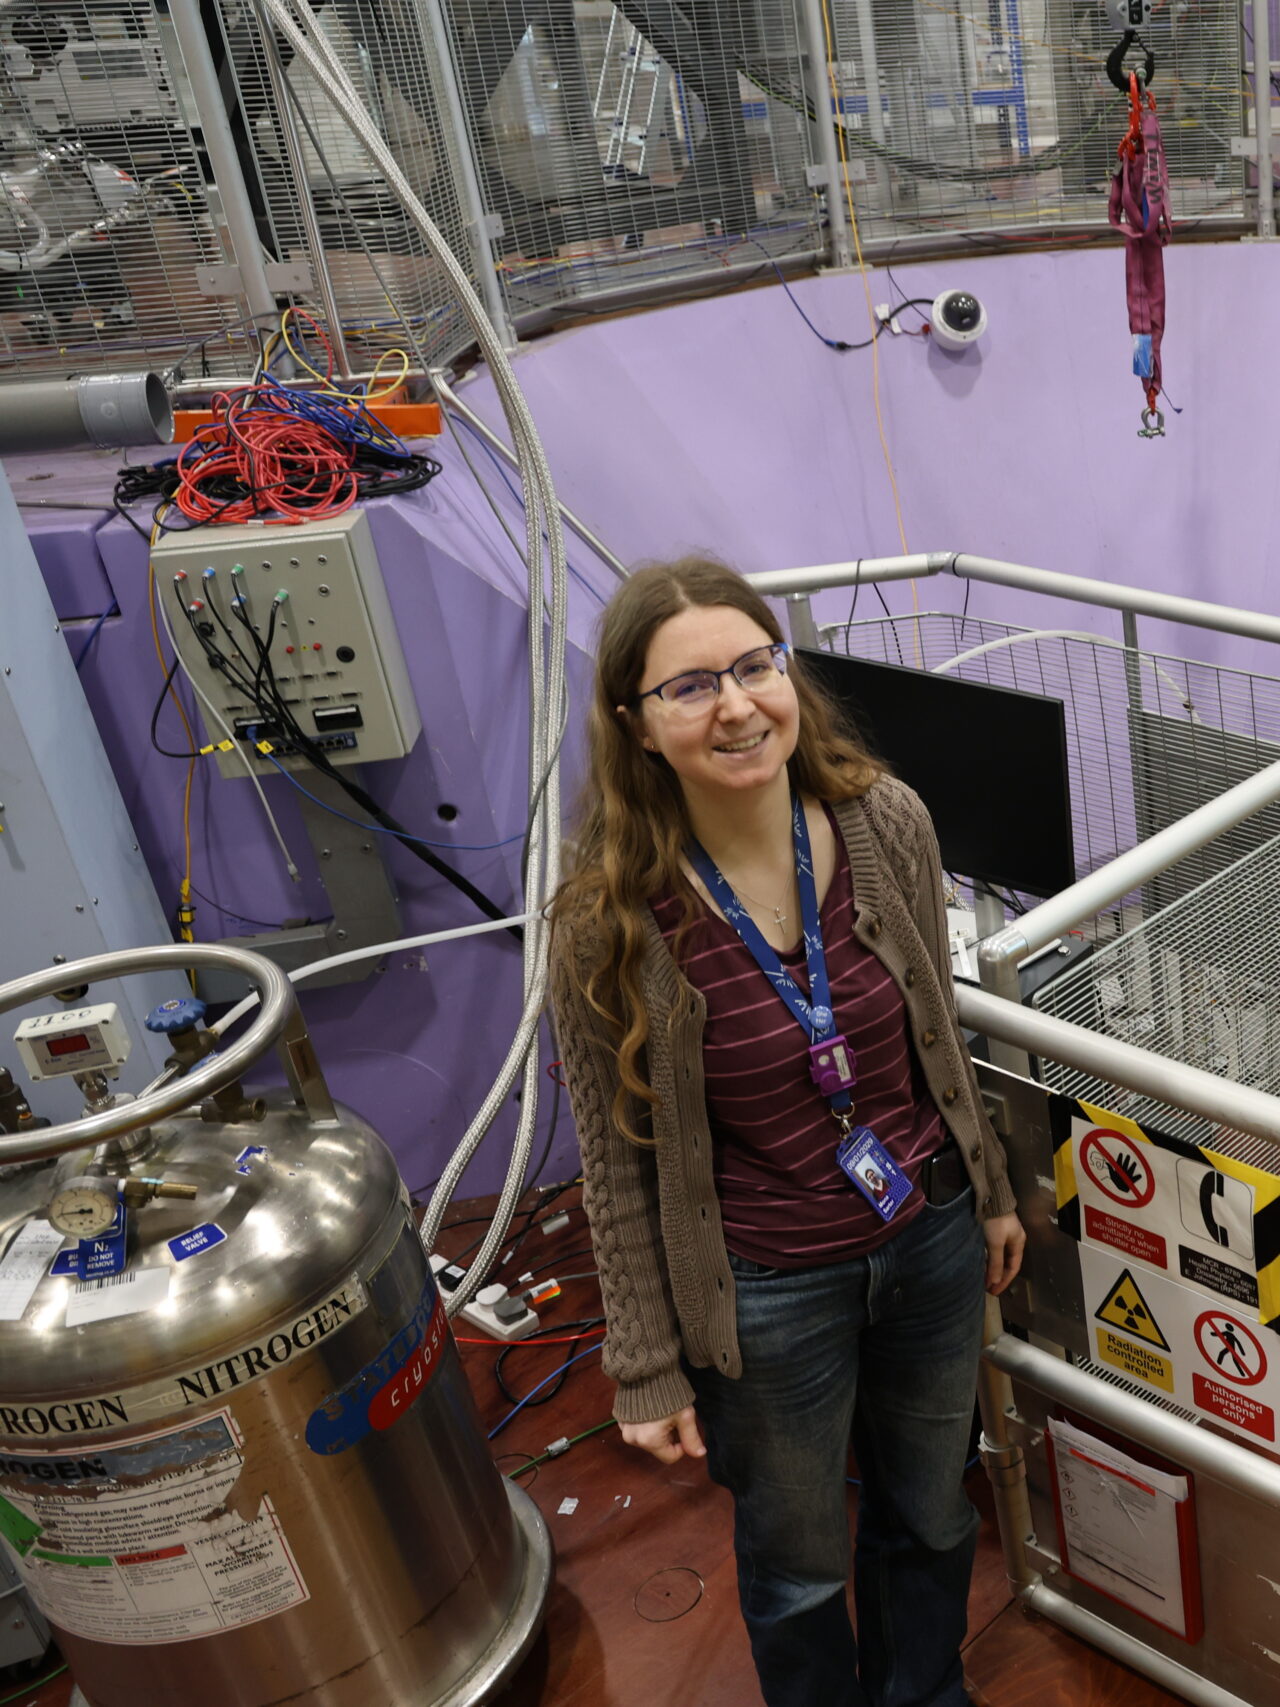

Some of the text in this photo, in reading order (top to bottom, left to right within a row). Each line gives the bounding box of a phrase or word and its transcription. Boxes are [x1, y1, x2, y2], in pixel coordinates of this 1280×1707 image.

[180, 1230, 205, 1247] RELIEF
[1093, 1220, 1160, 1254] admittance when
[1105, 1216, 1145, 1239] Strictly no
[185, 1236, 208, 1251] VALVE
[1102, 1232, 1151, 1258] shutter open
[87, 1260, 115, 1270] REMOVE
[88, 1252, 114, 1263] DO NOT
[1202, 1257, 1219, 1268] MCR
[1188, 1257, 1210, 1270] Health
[1210, 1265, 1235, 1282] Physics
[174, 1291, 352, 1406] NITROGEN
[1107, 1334, 1162, 1367] Radiation
[1107, 1343, 1165, 1377] controlled
[1124, 1362, 1149, 1379] area
[1204, 1380, 1263, 1414] Authorised
[1212, 1393, 1256, 1420] persons
[1222, 1407, 1246, 1425] only
[149, 1494, 183, 1508] cryogenic
[183, 1488, 205, 1498] burns
[205, 1557, 224, 1568] MAX
[224, 1539, 274, 1562] ALWABLE
[214, 1557, 253, 1577] PRESSURE
